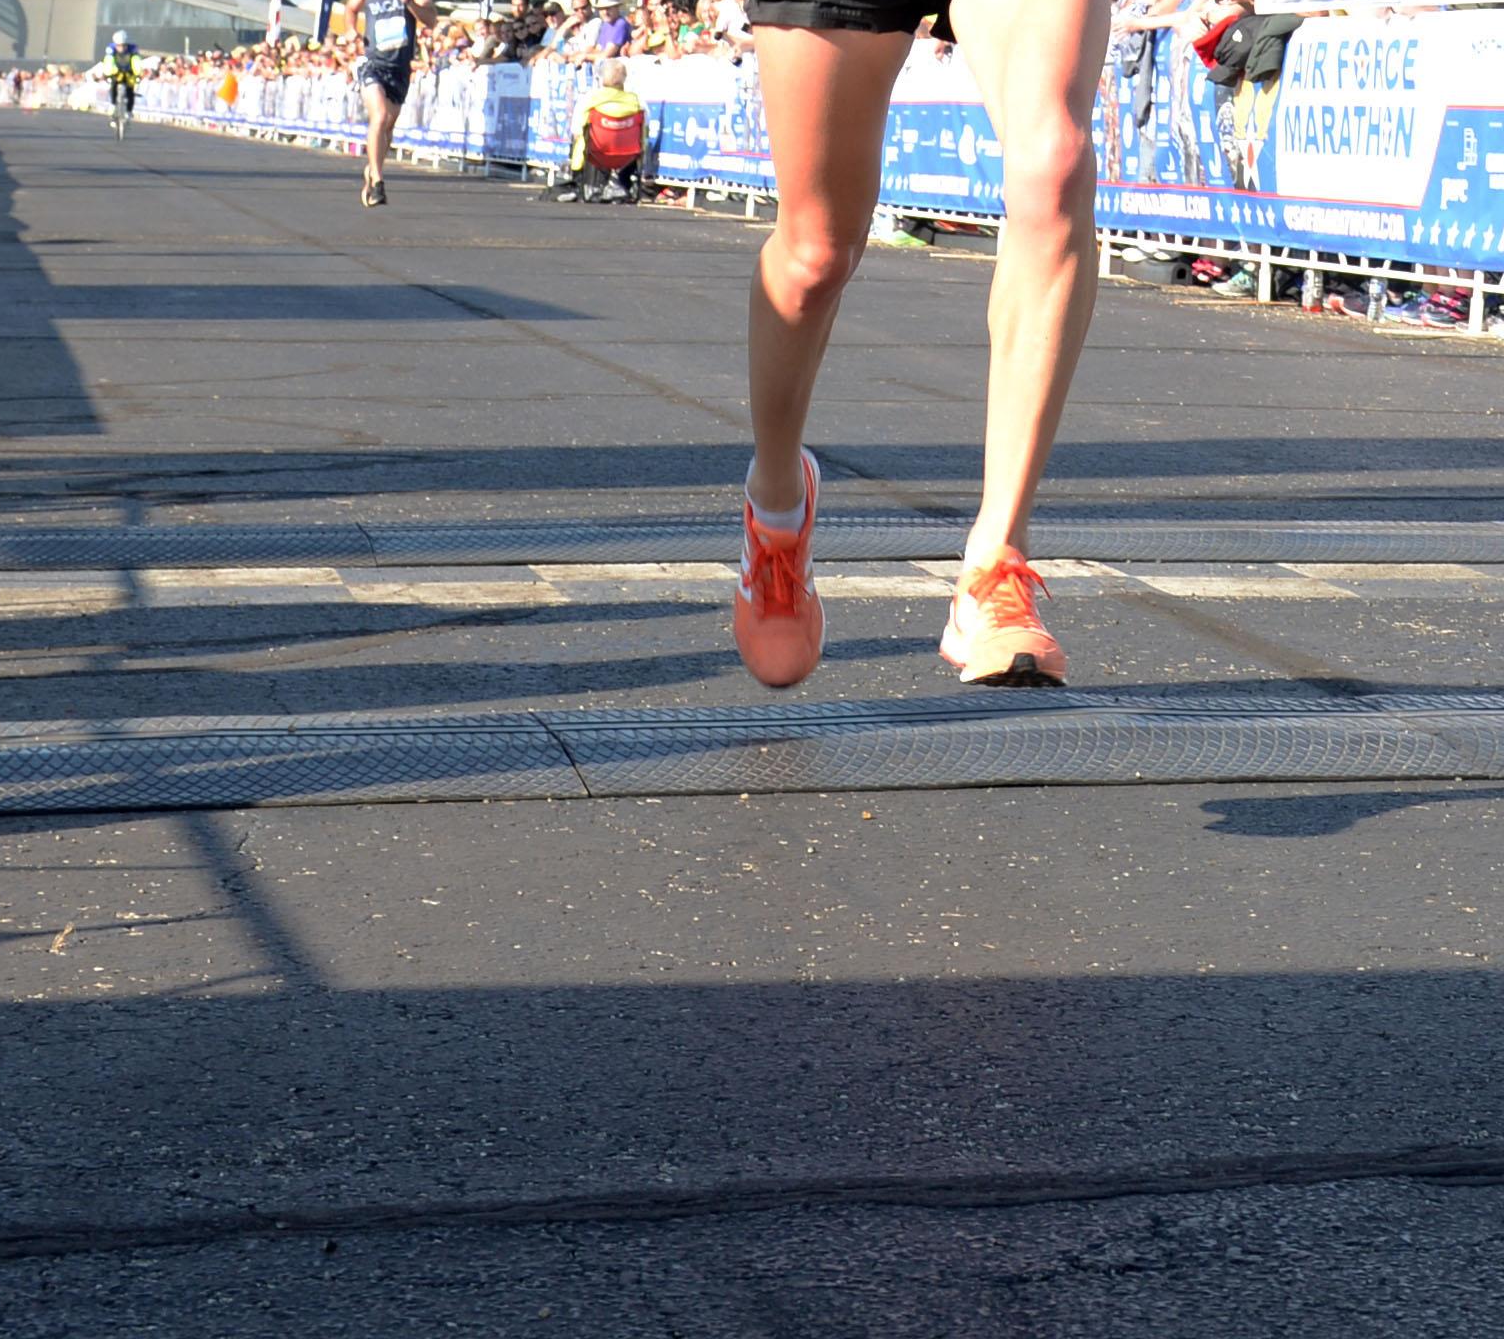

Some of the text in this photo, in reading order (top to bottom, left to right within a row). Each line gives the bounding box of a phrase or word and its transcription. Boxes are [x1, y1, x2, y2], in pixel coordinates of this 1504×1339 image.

[1290, 38, 1418, 90] AIR FORCE
[1283, 106, 1415, 158] MARATHON
